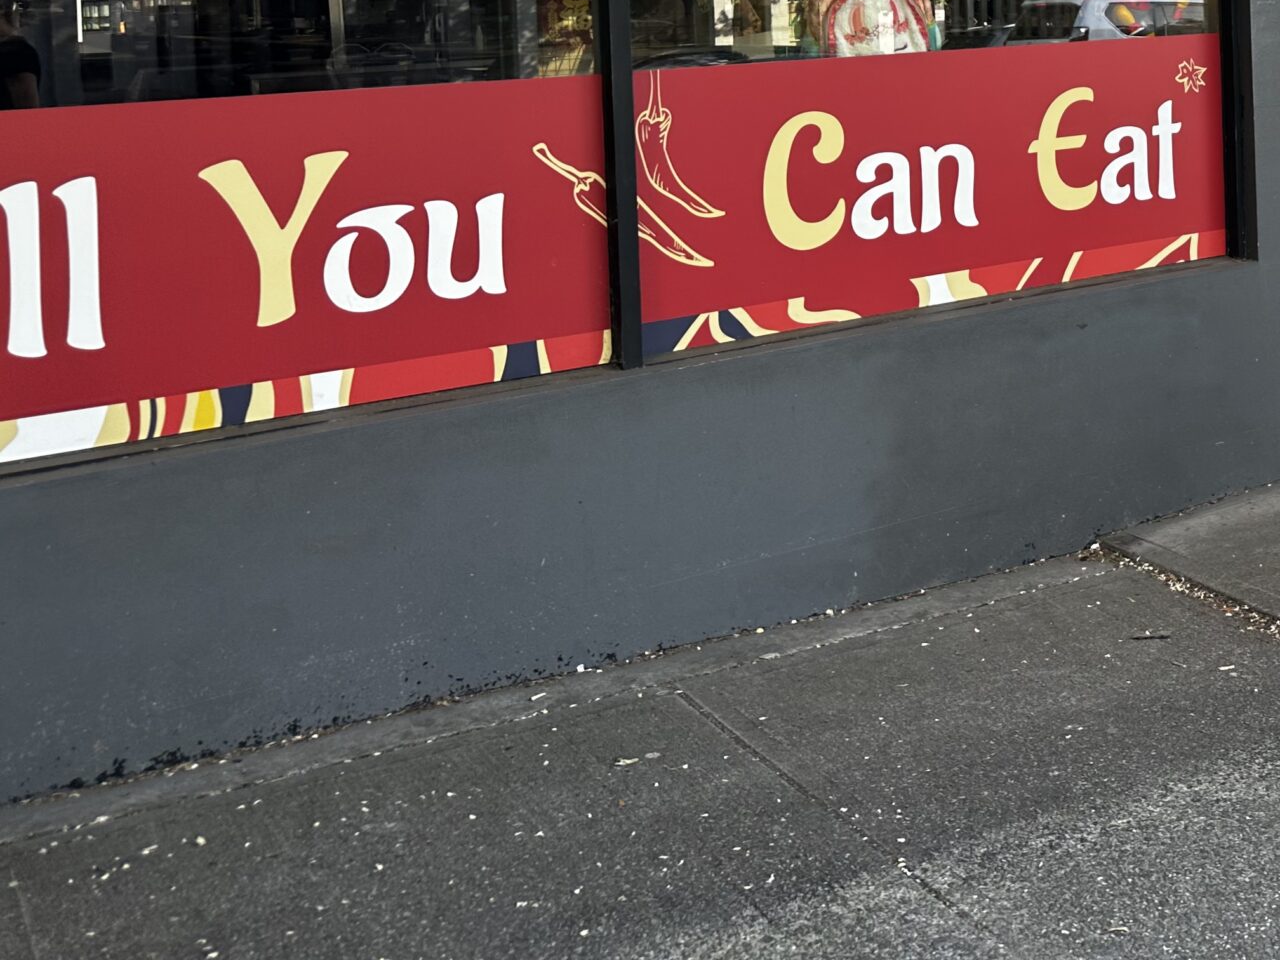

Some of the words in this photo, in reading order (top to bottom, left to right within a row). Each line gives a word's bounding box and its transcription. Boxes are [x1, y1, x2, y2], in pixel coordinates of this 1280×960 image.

[197, 150, 507, 328] You
[763, 110, 980, 251] Can
[1027, 86, 1183, 211] Eat
